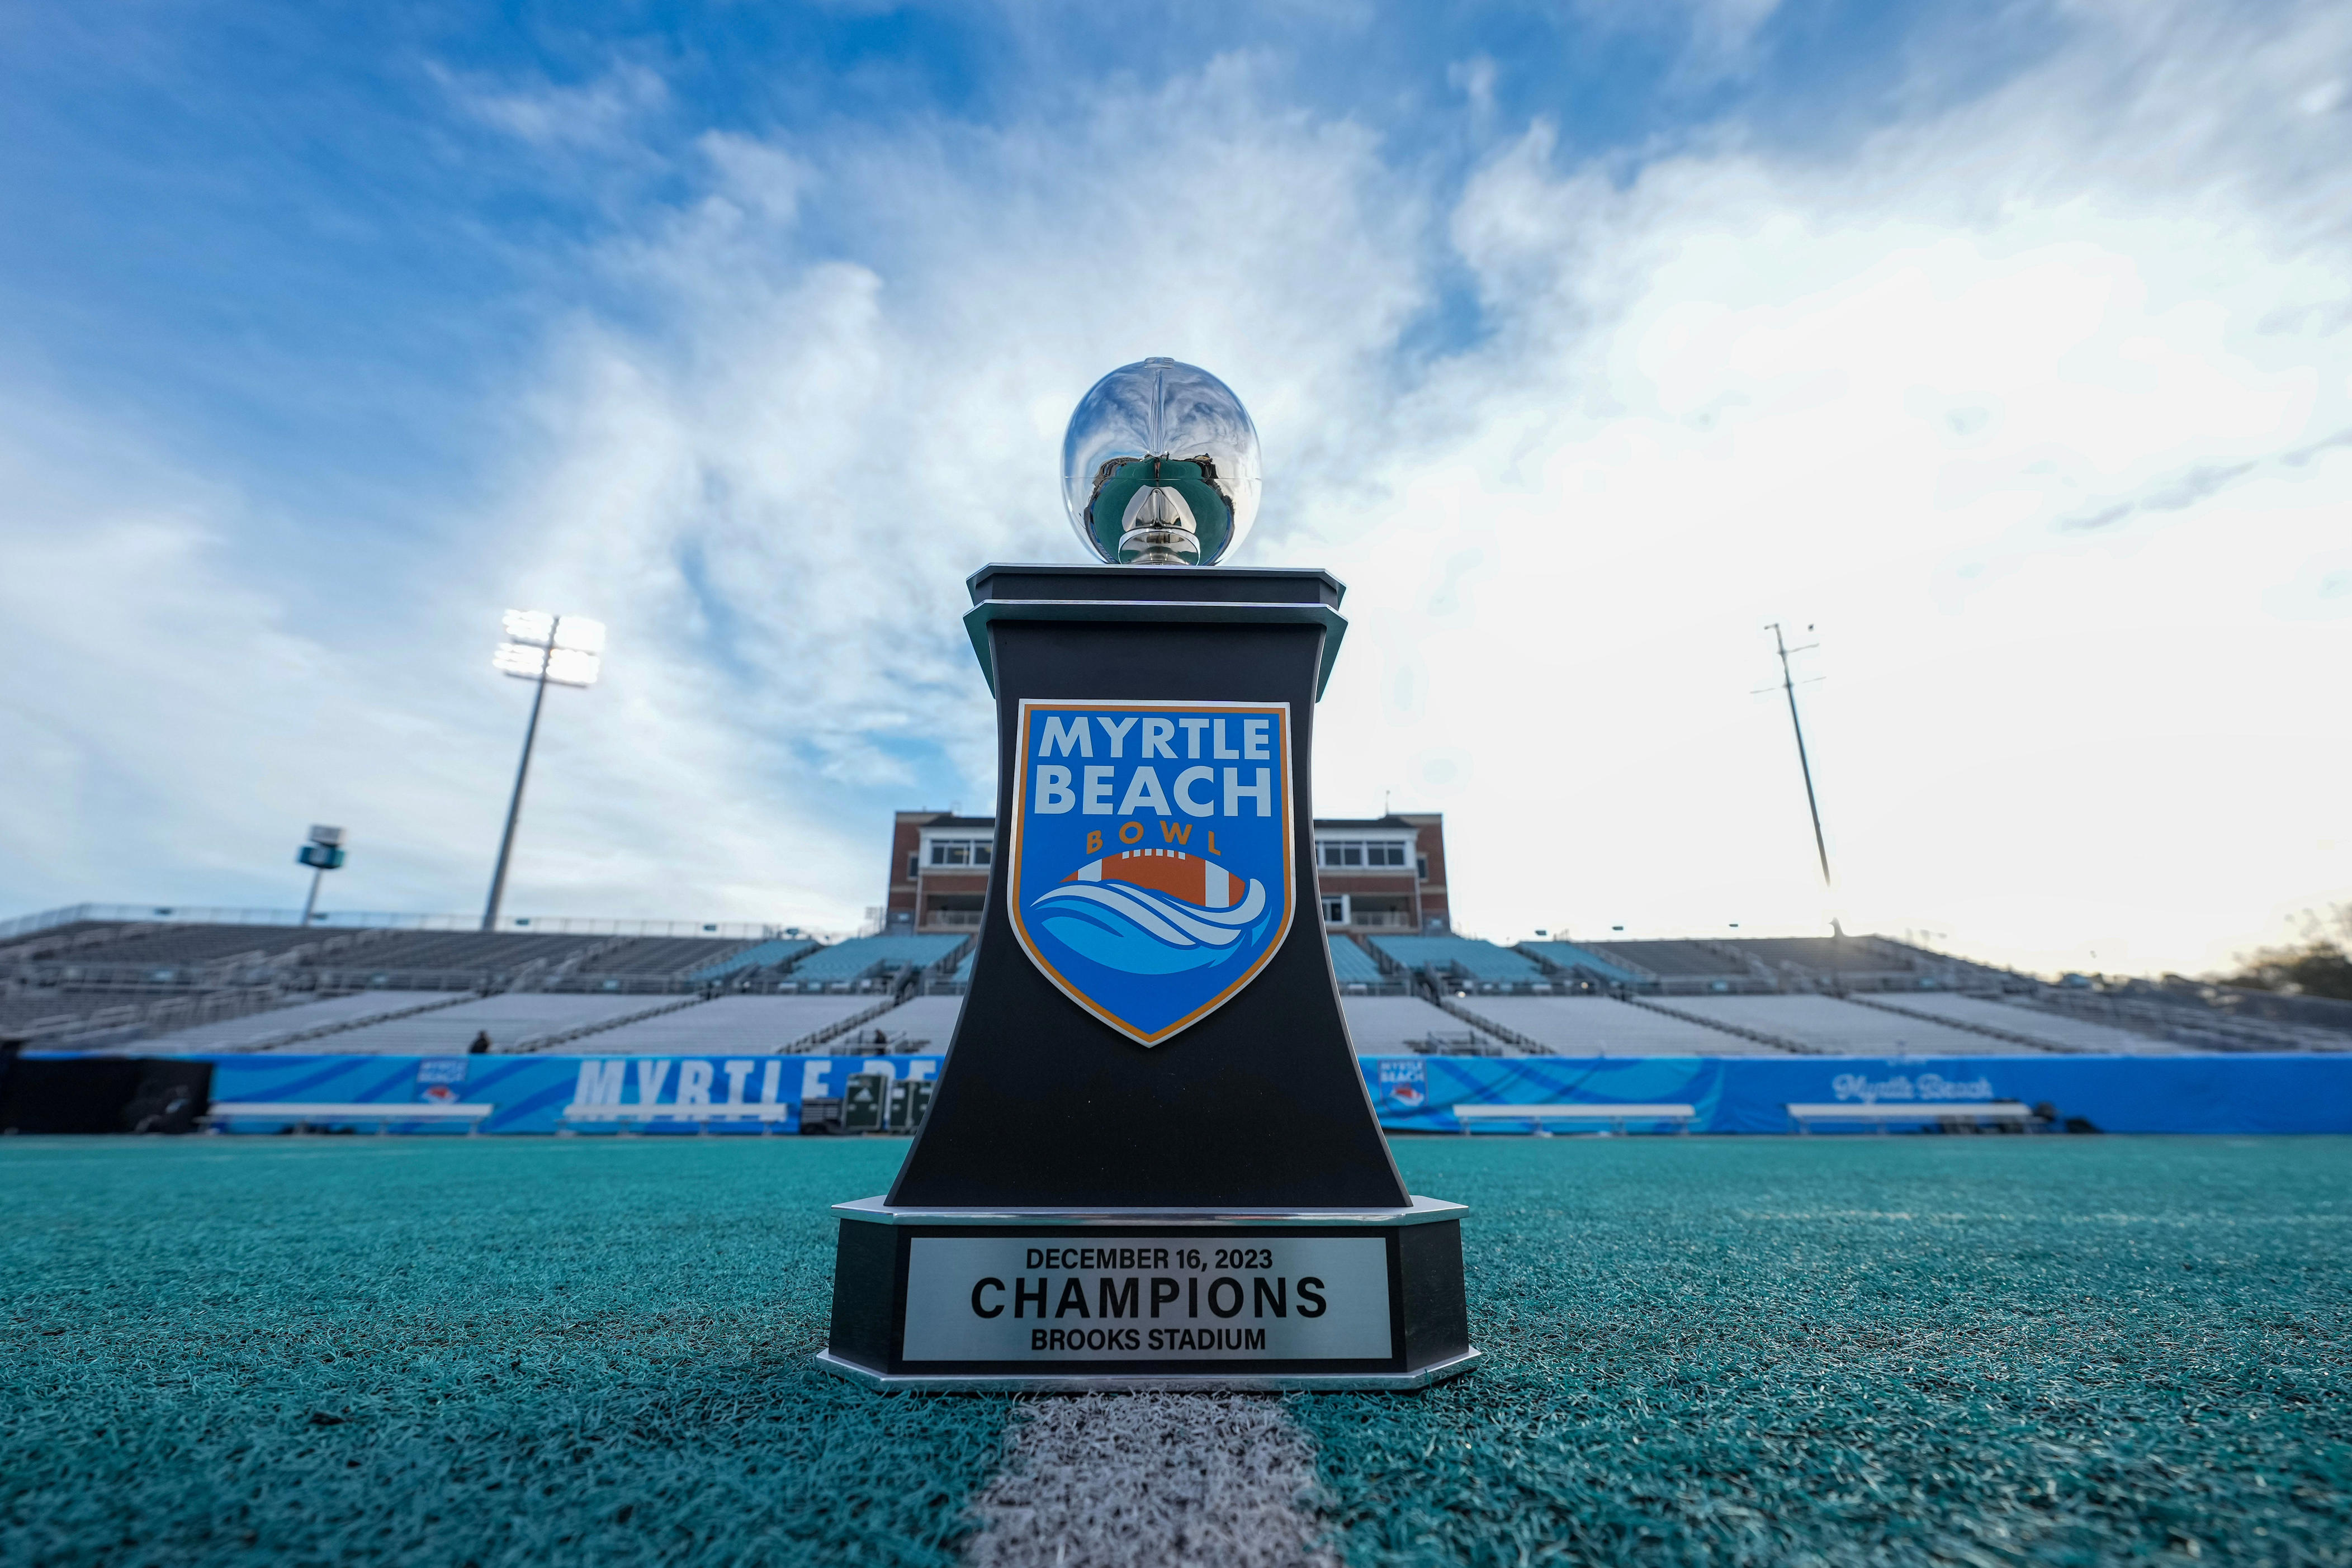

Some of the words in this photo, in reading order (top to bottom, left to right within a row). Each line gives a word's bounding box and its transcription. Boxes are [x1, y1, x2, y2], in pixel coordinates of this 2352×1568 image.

[1038, 716, 1270, 760] MYRTLE
[1034, 765, 1271, 817] BEACH
[1086, 821, 1221, 856] BOWL
[571, 1060, 832, 1121] MYRTLE
[1026, 1248, 1168, 1269] DECEMBER
[1176, 1249, 1207, 1272] 16,
[1215, 1249, 1273, 1269] 2023
[971, 1277, 1327, 1318] CHAMPIONS
[1031, 1328, 1141, 1351] BROOKS
[1148, 1328, 1266, 1351] STADIUM
